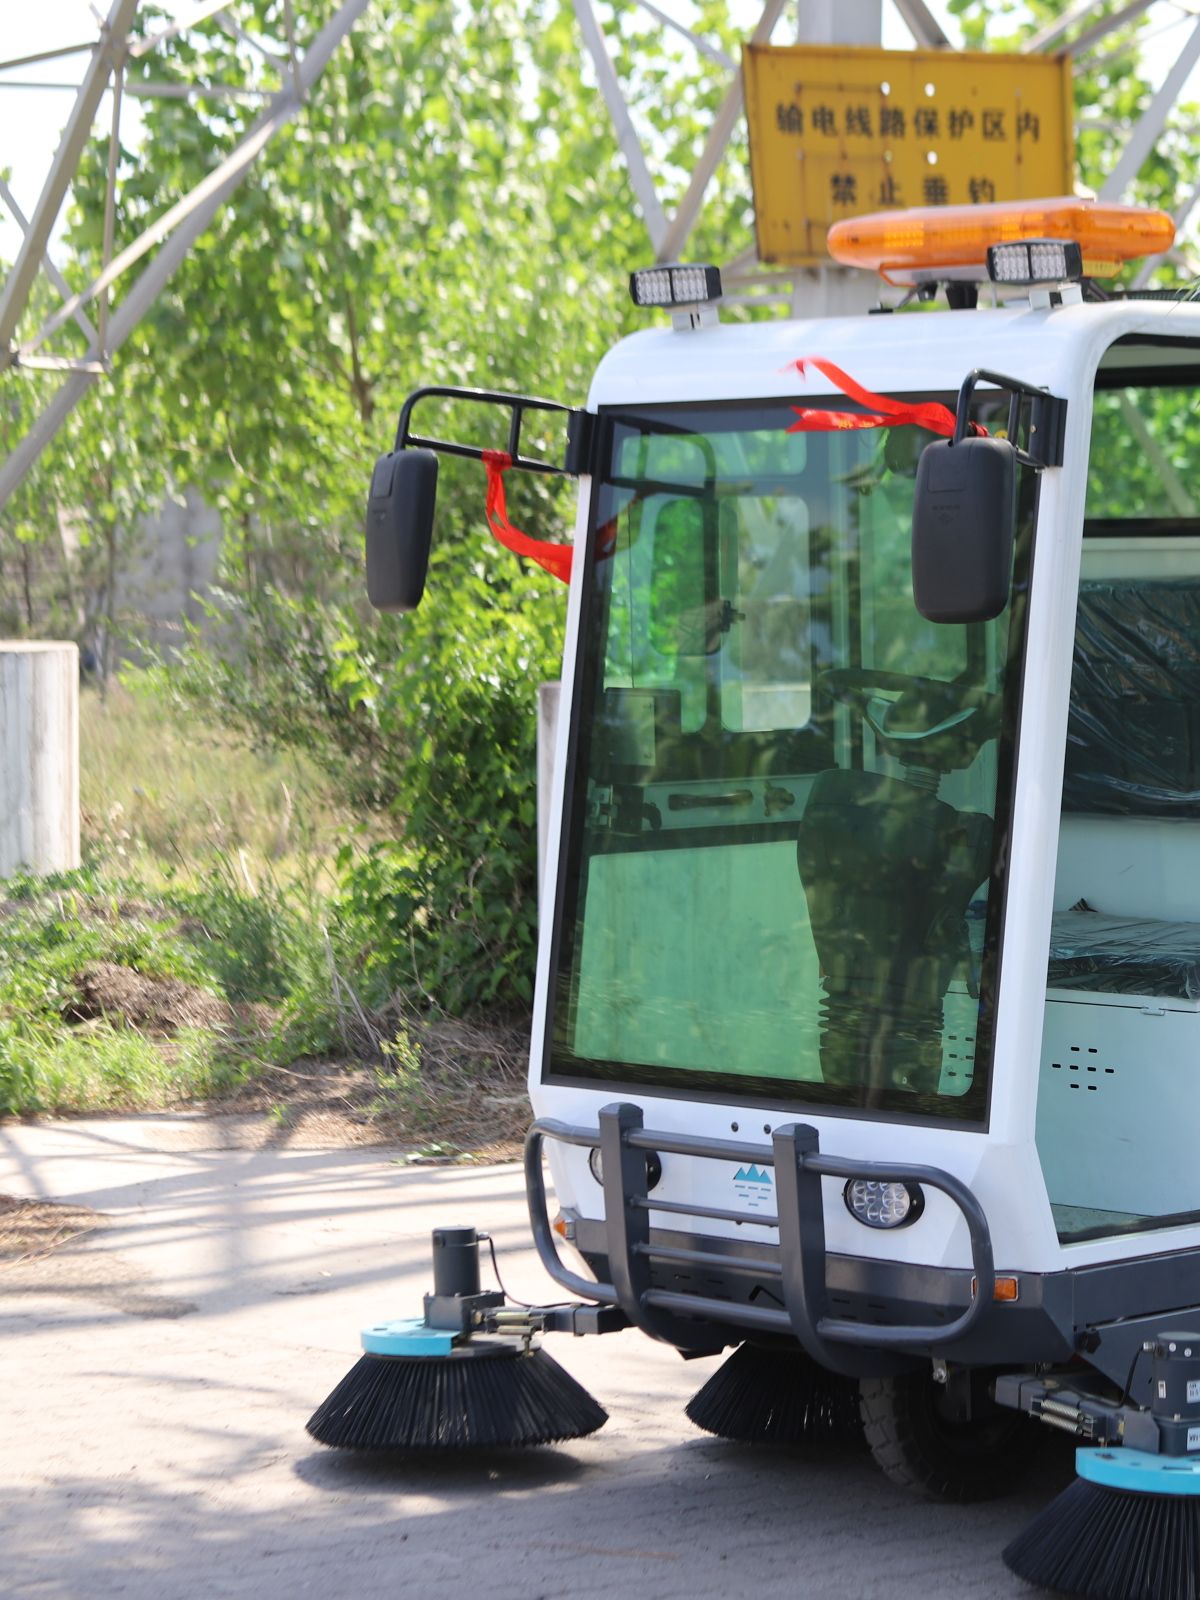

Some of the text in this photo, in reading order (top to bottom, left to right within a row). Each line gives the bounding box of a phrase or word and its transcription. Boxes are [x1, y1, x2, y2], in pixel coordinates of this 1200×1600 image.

[776, 103, 1040, 142] 输电线路保护区内
[830, 174, 996, 205] 禁止垂钓
